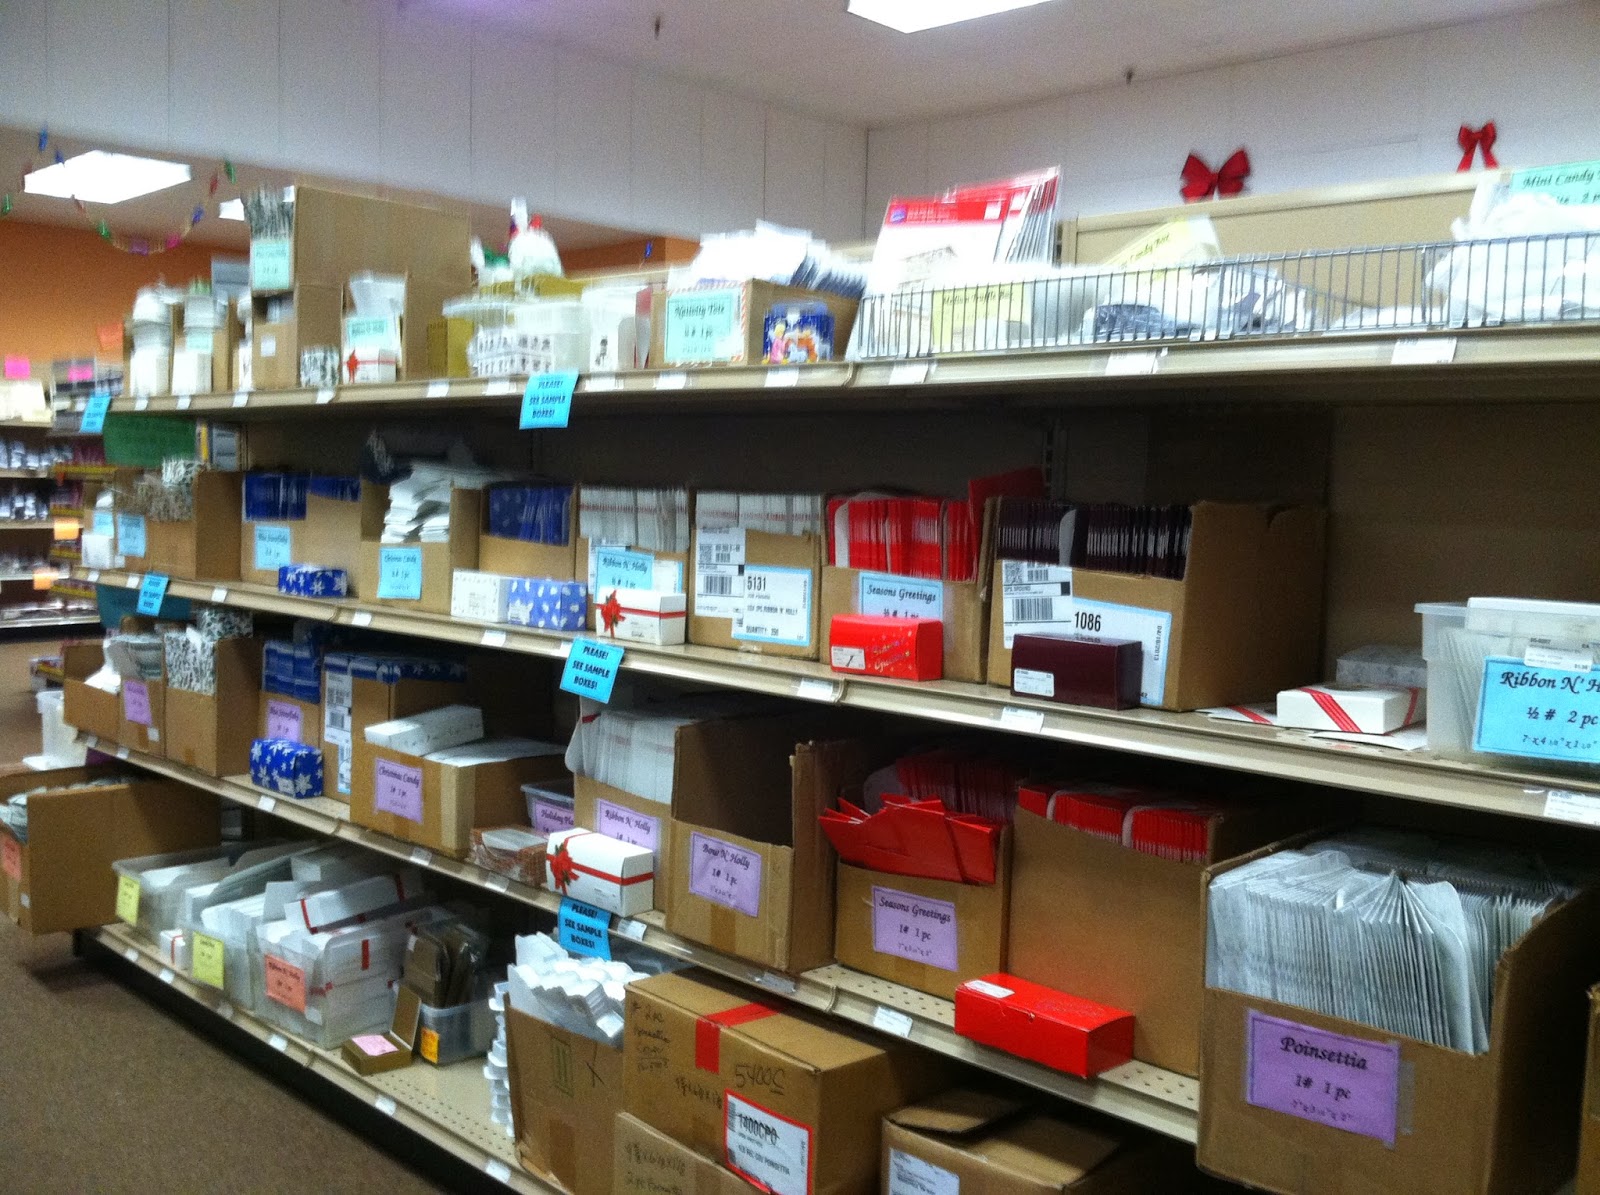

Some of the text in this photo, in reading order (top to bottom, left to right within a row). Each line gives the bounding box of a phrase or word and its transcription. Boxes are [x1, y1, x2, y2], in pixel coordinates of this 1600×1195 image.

[747, 575, 766, 591] 5131
[866, 584, 936, 605] Seasons Greetings
[1074, 611, 1102, 633] 1086
[583, 646, 609, 660] PLEASE!
[572, 660, 610, 679] SEE SAMPLE
[573, 675, 598, 690] BOXES!
[1500, 671, 1556, 689] Ribbon
[1560, 675, 1585, 694] N'
[1544, 708, 1556, 721] #
[1567, 710, 1578, 723] 2
[1579, 715, 1599, 730] pc
[730, 853, 750, 871] Holly
[571, 903, 597, 919] PLEASE!
[879, 896, 951, 925] Seasons Greetings
[565, 918, 603, 939] SEE SAMPLE
[571, 933, 595, 949] BOXES!
[1280, 1036, 1368, 1071] Poinsettia
[1334, 1085, 1351, 1101] pc
